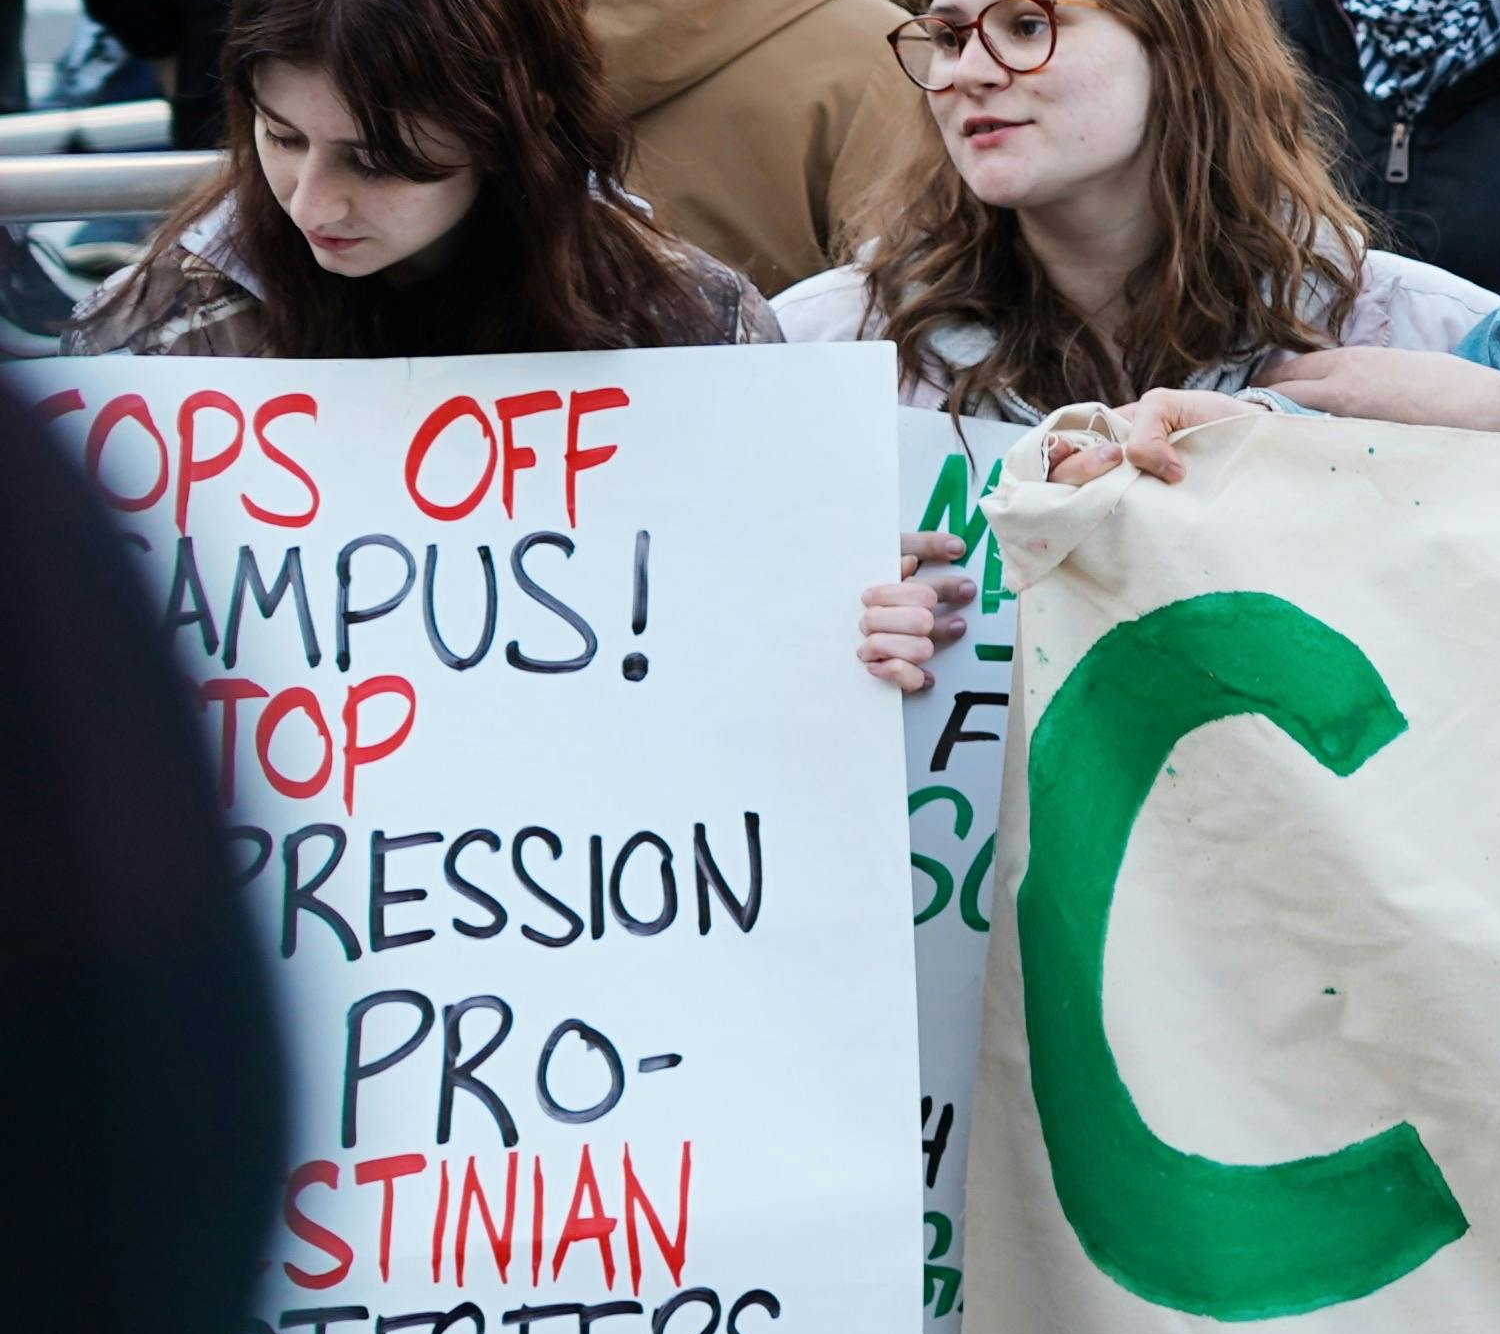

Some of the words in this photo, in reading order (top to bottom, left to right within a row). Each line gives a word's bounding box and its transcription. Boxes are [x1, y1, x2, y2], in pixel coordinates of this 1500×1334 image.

[34, 388, 321, 536] OPS
[405, 386, 631, 529] OFF
[122, 530, 651, 682] AMPUS!
[198, 674, 417, 816] TOP
[341, 988, 684, 1150] PRO-
[282, 1141, 692, 1297] STINIAN
